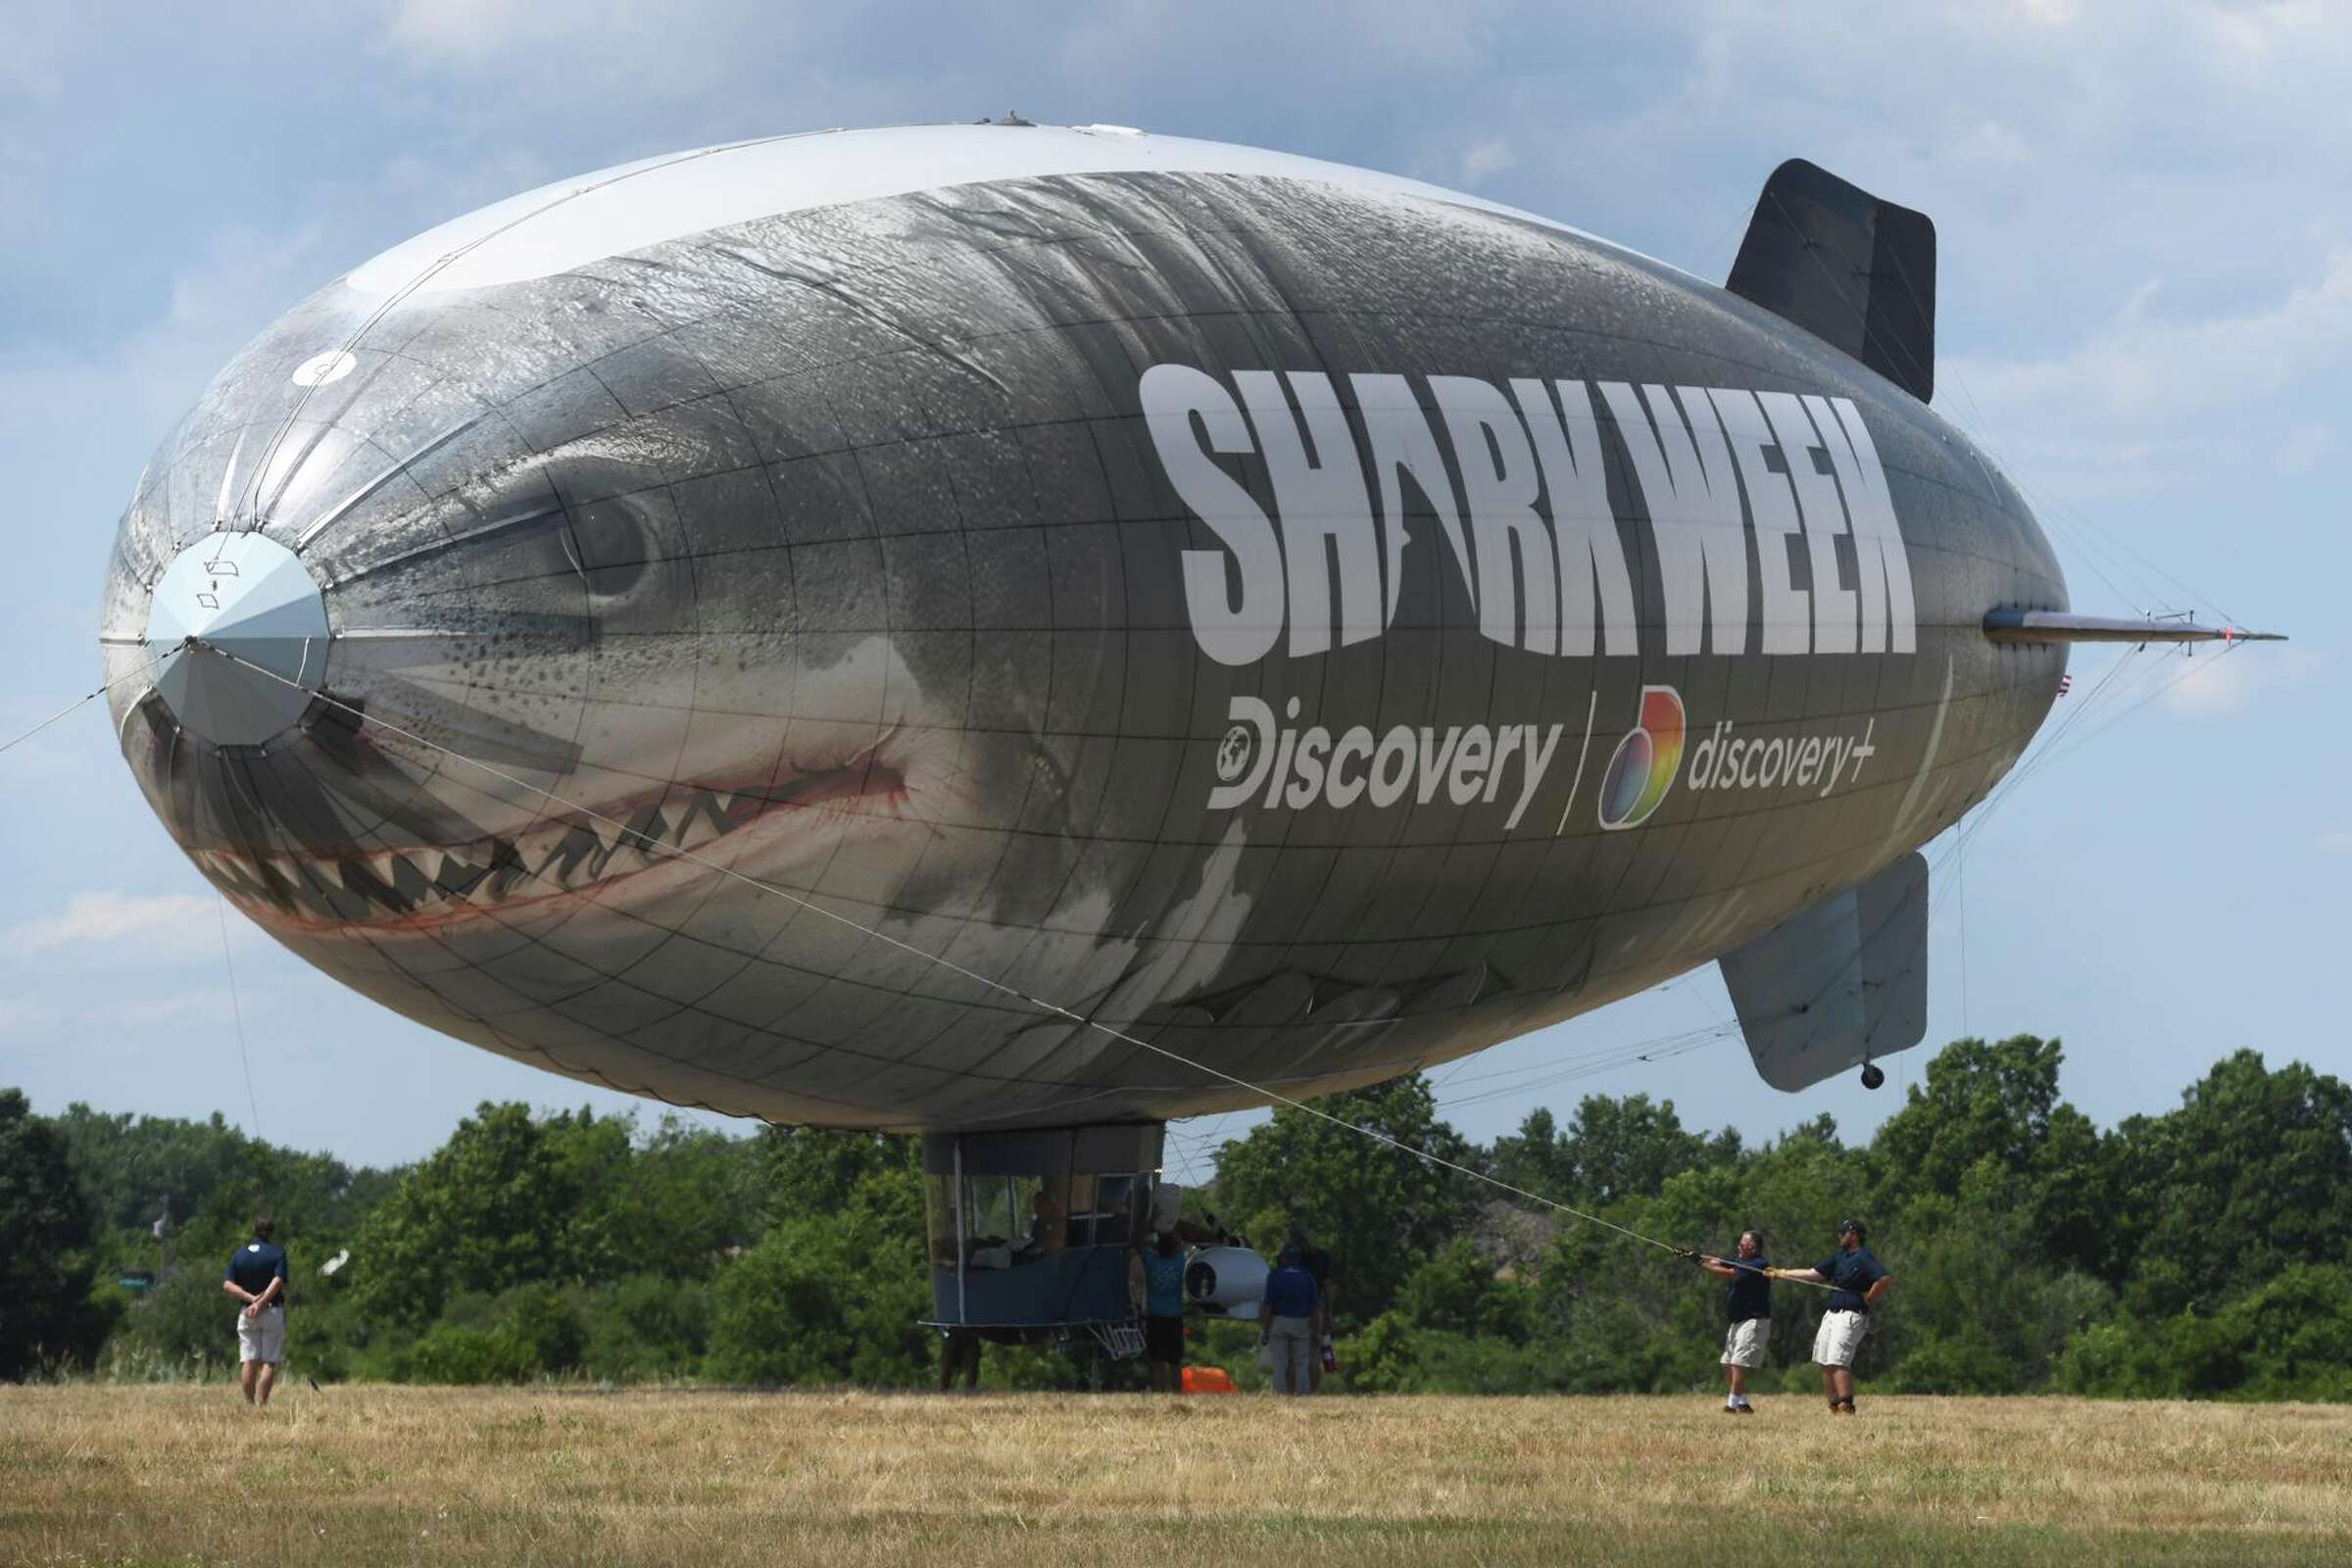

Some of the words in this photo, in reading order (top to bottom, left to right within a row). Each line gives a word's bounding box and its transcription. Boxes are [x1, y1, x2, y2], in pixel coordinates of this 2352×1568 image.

[1139, 364, 1640, 665] SHARK
[1595, 379, 1917, 657] WEEK
[1207, 697, 1563, 830] Discovery
[1688, 718, 1876, 797] discovery+
